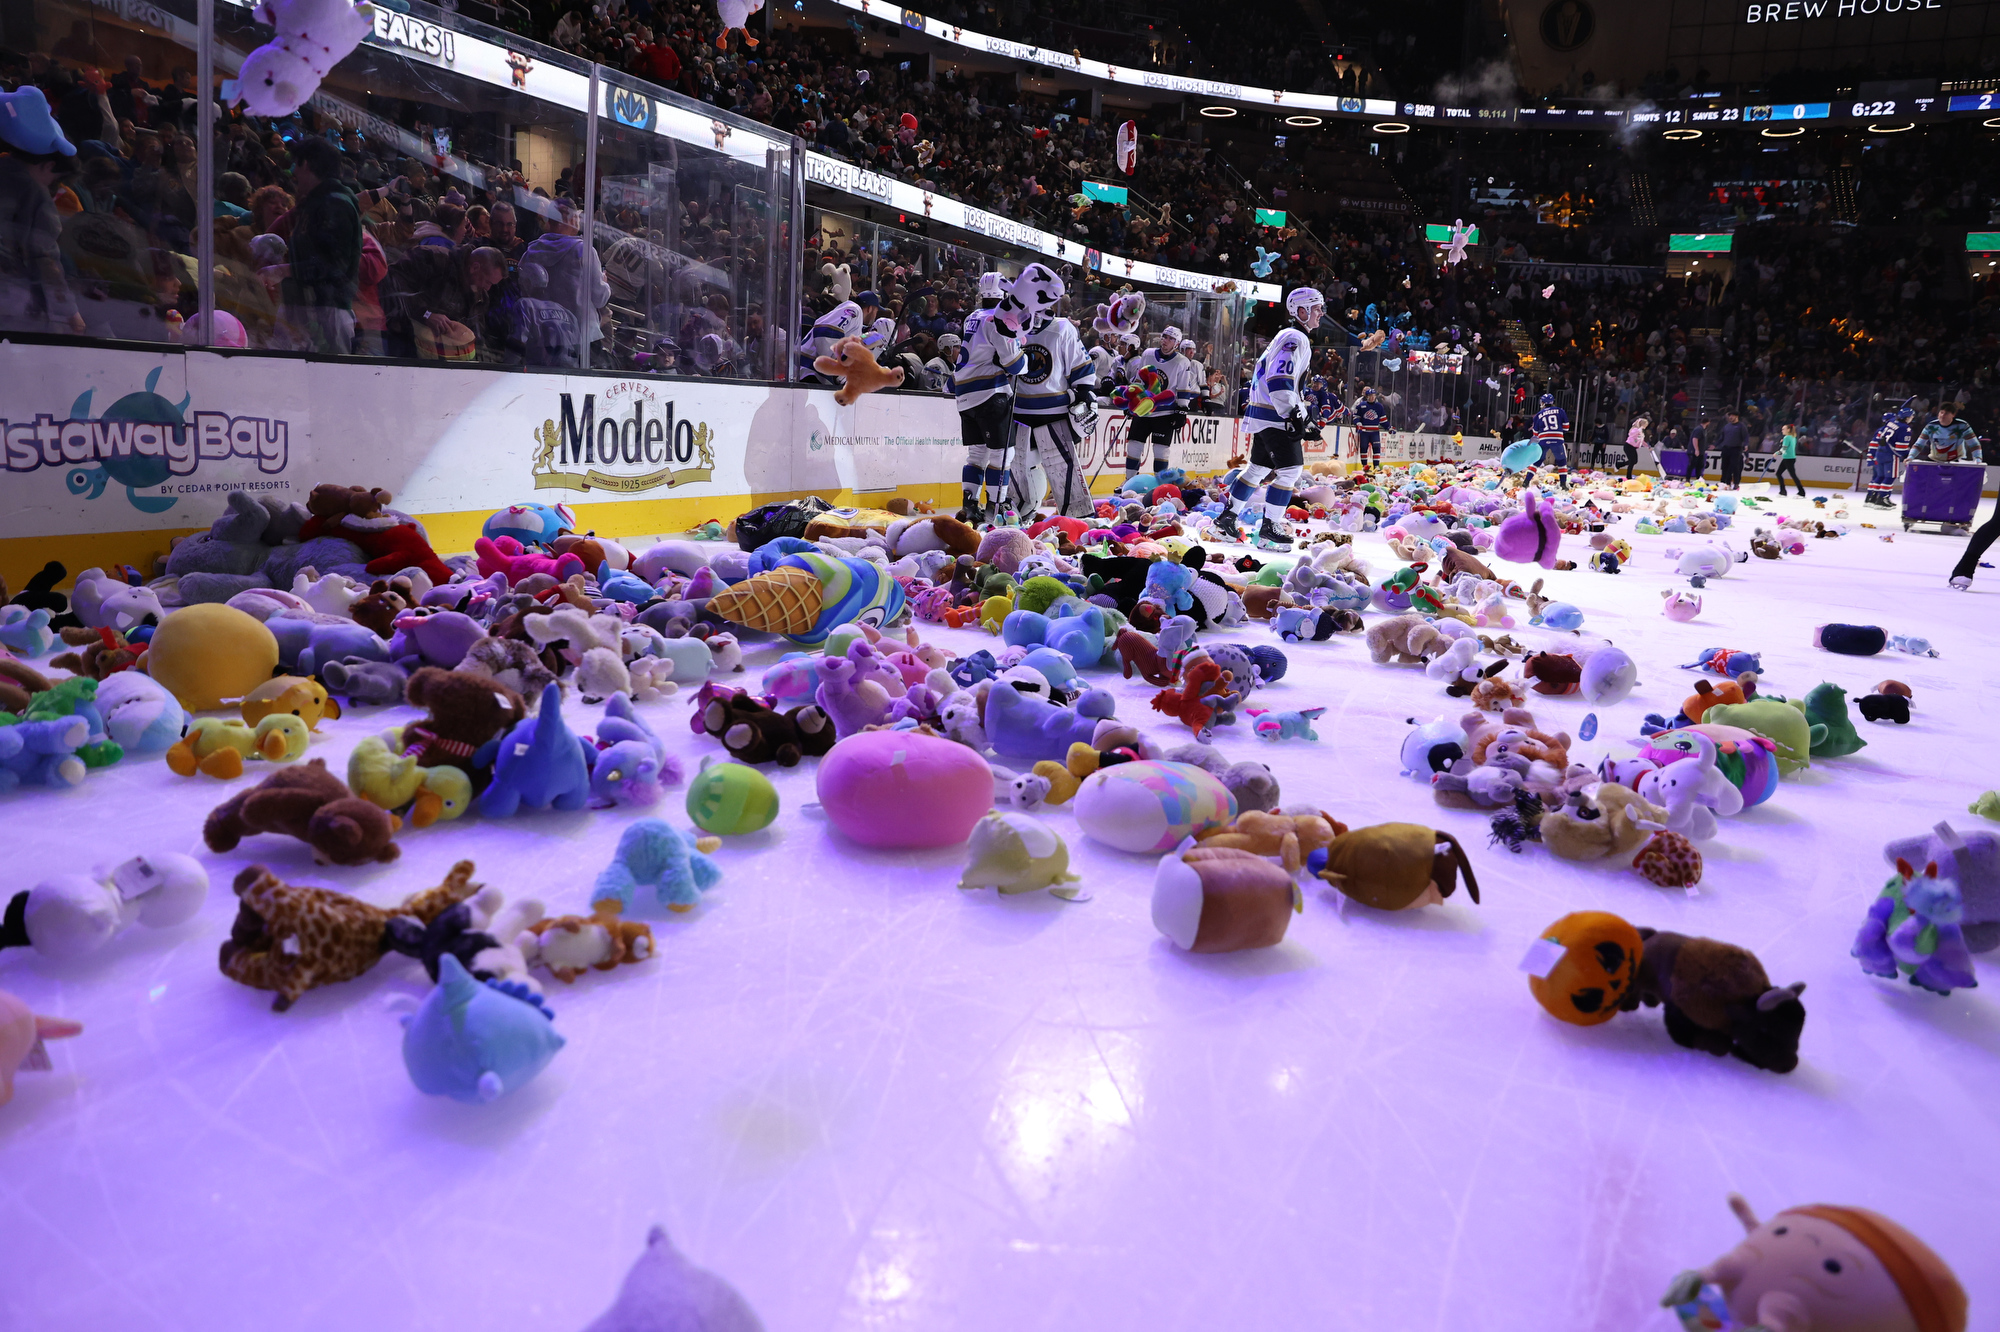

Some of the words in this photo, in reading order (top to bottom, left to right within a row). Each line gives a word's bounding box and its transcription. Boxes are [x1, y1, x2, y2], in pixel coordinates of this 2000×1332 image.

[1746, 0, 1828, 23] BREW
[373, 9, 455, 63] EARS!
[986, 37, 1011, 52] TOSS
[1143, 73, 1168, 87] TOSS
[1172, 78, 1203, 92] THOSE
[1207, 82, 1241, 97] BEARS!
[1852, 101, 1896, 117] 6:22
[1919, 104, 1927, 112] 2
[1977, 94, 1993, 110] 2
[1446, 108, 1471, 118] TOTAL
[1478, 109, 1507, 119] $9,114
[1633, 113, 1660, 122] SHOTS
[1664, 110, 1681, 123] 12
[1692, 111, 1718, 121] SAVES
[1722, 108, 1739, 121] 23
[1792, 104, 1805, 119] 0
[807, 157, 848, 189] THOSE
[852, 168, 893, 199] BEARS!
[1351, 200, 1407, 211] WESTFIELD
[964, 207, 986, 230] TOSS
[989, 217, 1014, 239] THOSE
[1016, 226, 1043, 248] BEARS!
[1156, 267, 1176, 284] TOSS
[1180, 273, 1208, 290] THOSE
[1507, 265, 1545, 282] THE
[1550, 266, 1599, 283] DEEP
[1603, 268, 1643, 285] END
[1276, 360, 1294, 375] 20
[606, 382, 656, 401] CERVEZA
[559, 393, 694, 466] Modelo
[1542, 415, 1558, 431] 19
[824, 435, 853, 446] MEDICAL
[854, 435, 880, 446] MUTUAL
[884, 436, 894, 446] The
[895, 436, 914, 446] Official
[915, 436, 932, 446] Health
[932, 436, 950, 446] Insurer
[1182, 449, 1209, 467] Mortgage
[161, 485, 174, 494] BY
[178, 484, 212, 494] CEDAR
[215, 482, 247, 492] POINT
[249, 481, 290, 490] RESORTS
[621, 479, 640, 489] 1925
